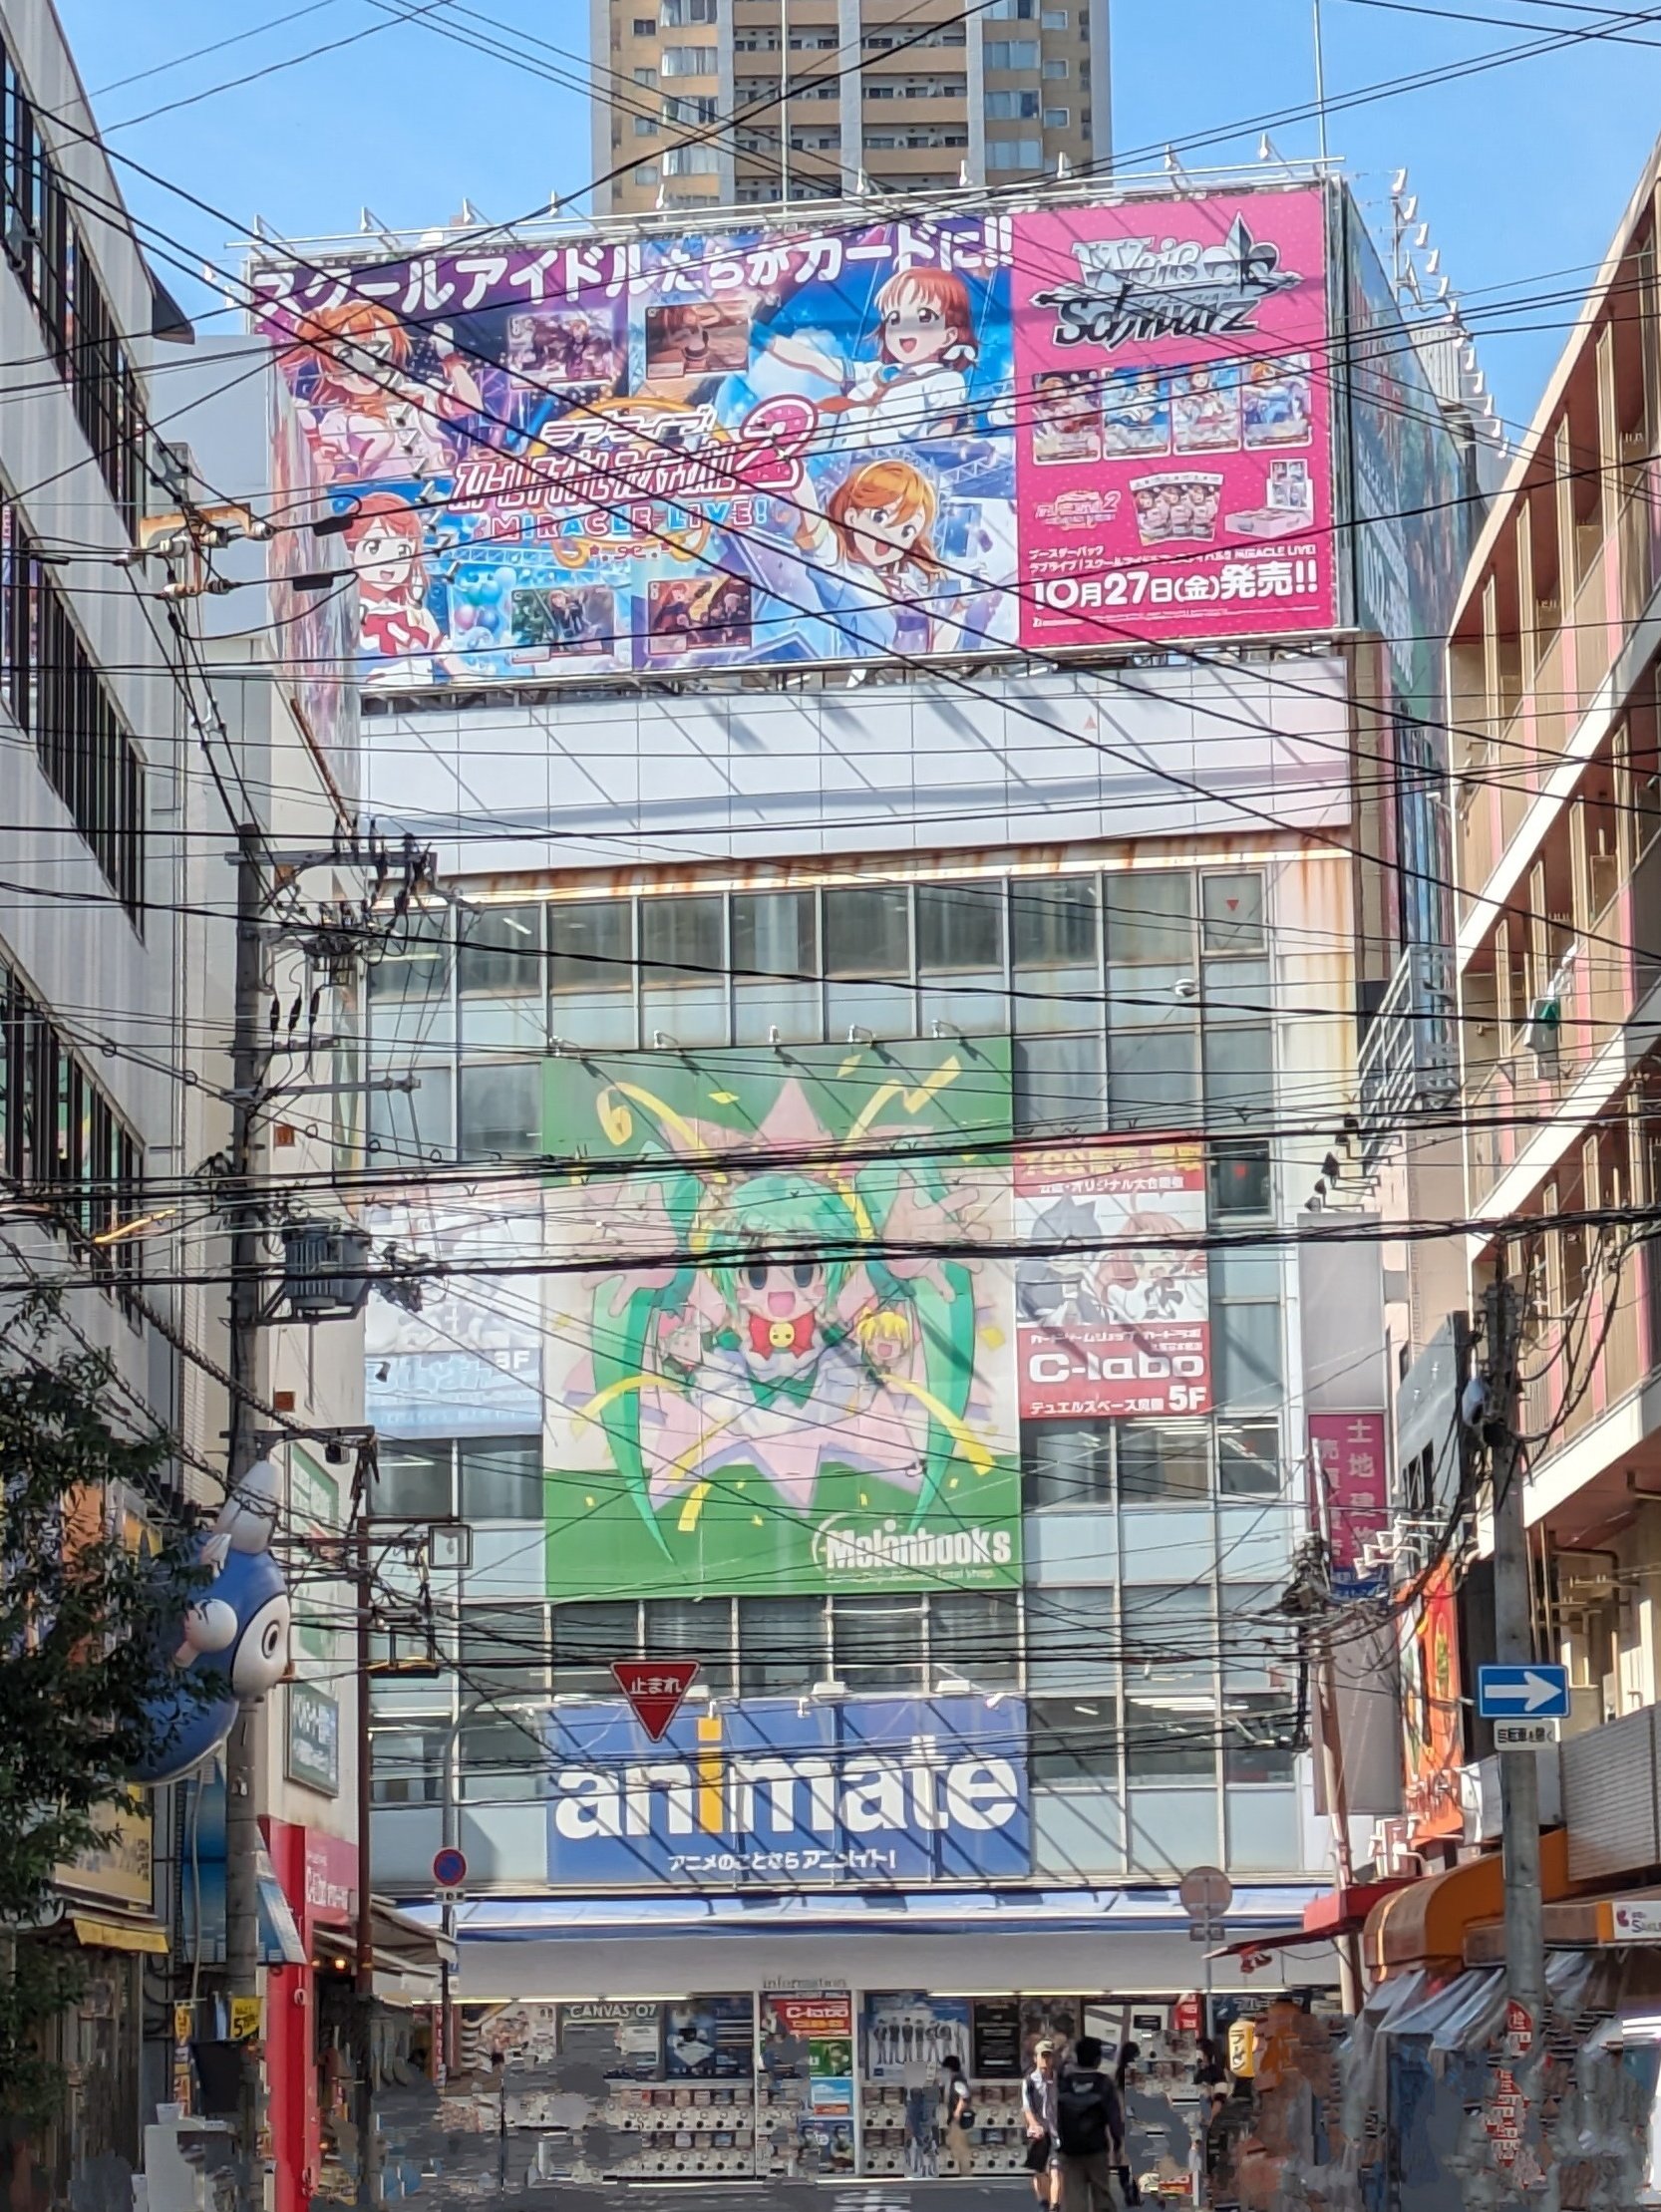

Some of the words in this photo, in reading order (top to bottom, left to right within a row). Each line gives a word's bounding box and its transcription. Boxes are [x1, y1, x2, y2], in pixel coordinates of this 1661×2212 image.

[490, 506, 654, 543] MIRACLE
[666, 496, 770, 533] LIVE!
[1032, 559, 1318, 610] 10月27日(金)発売!!
[1029, 1351, 1204, 1383] C-labo
[1167, 1385, 1207, 1412] 5F
[827, 1518, 1012, 1569] Melonbooks
[629, 1677, 683, 1695] 止まれ
[555, 1717, 1018, 1840] animate
[569, 2003, 630, 2019] CANVAS
